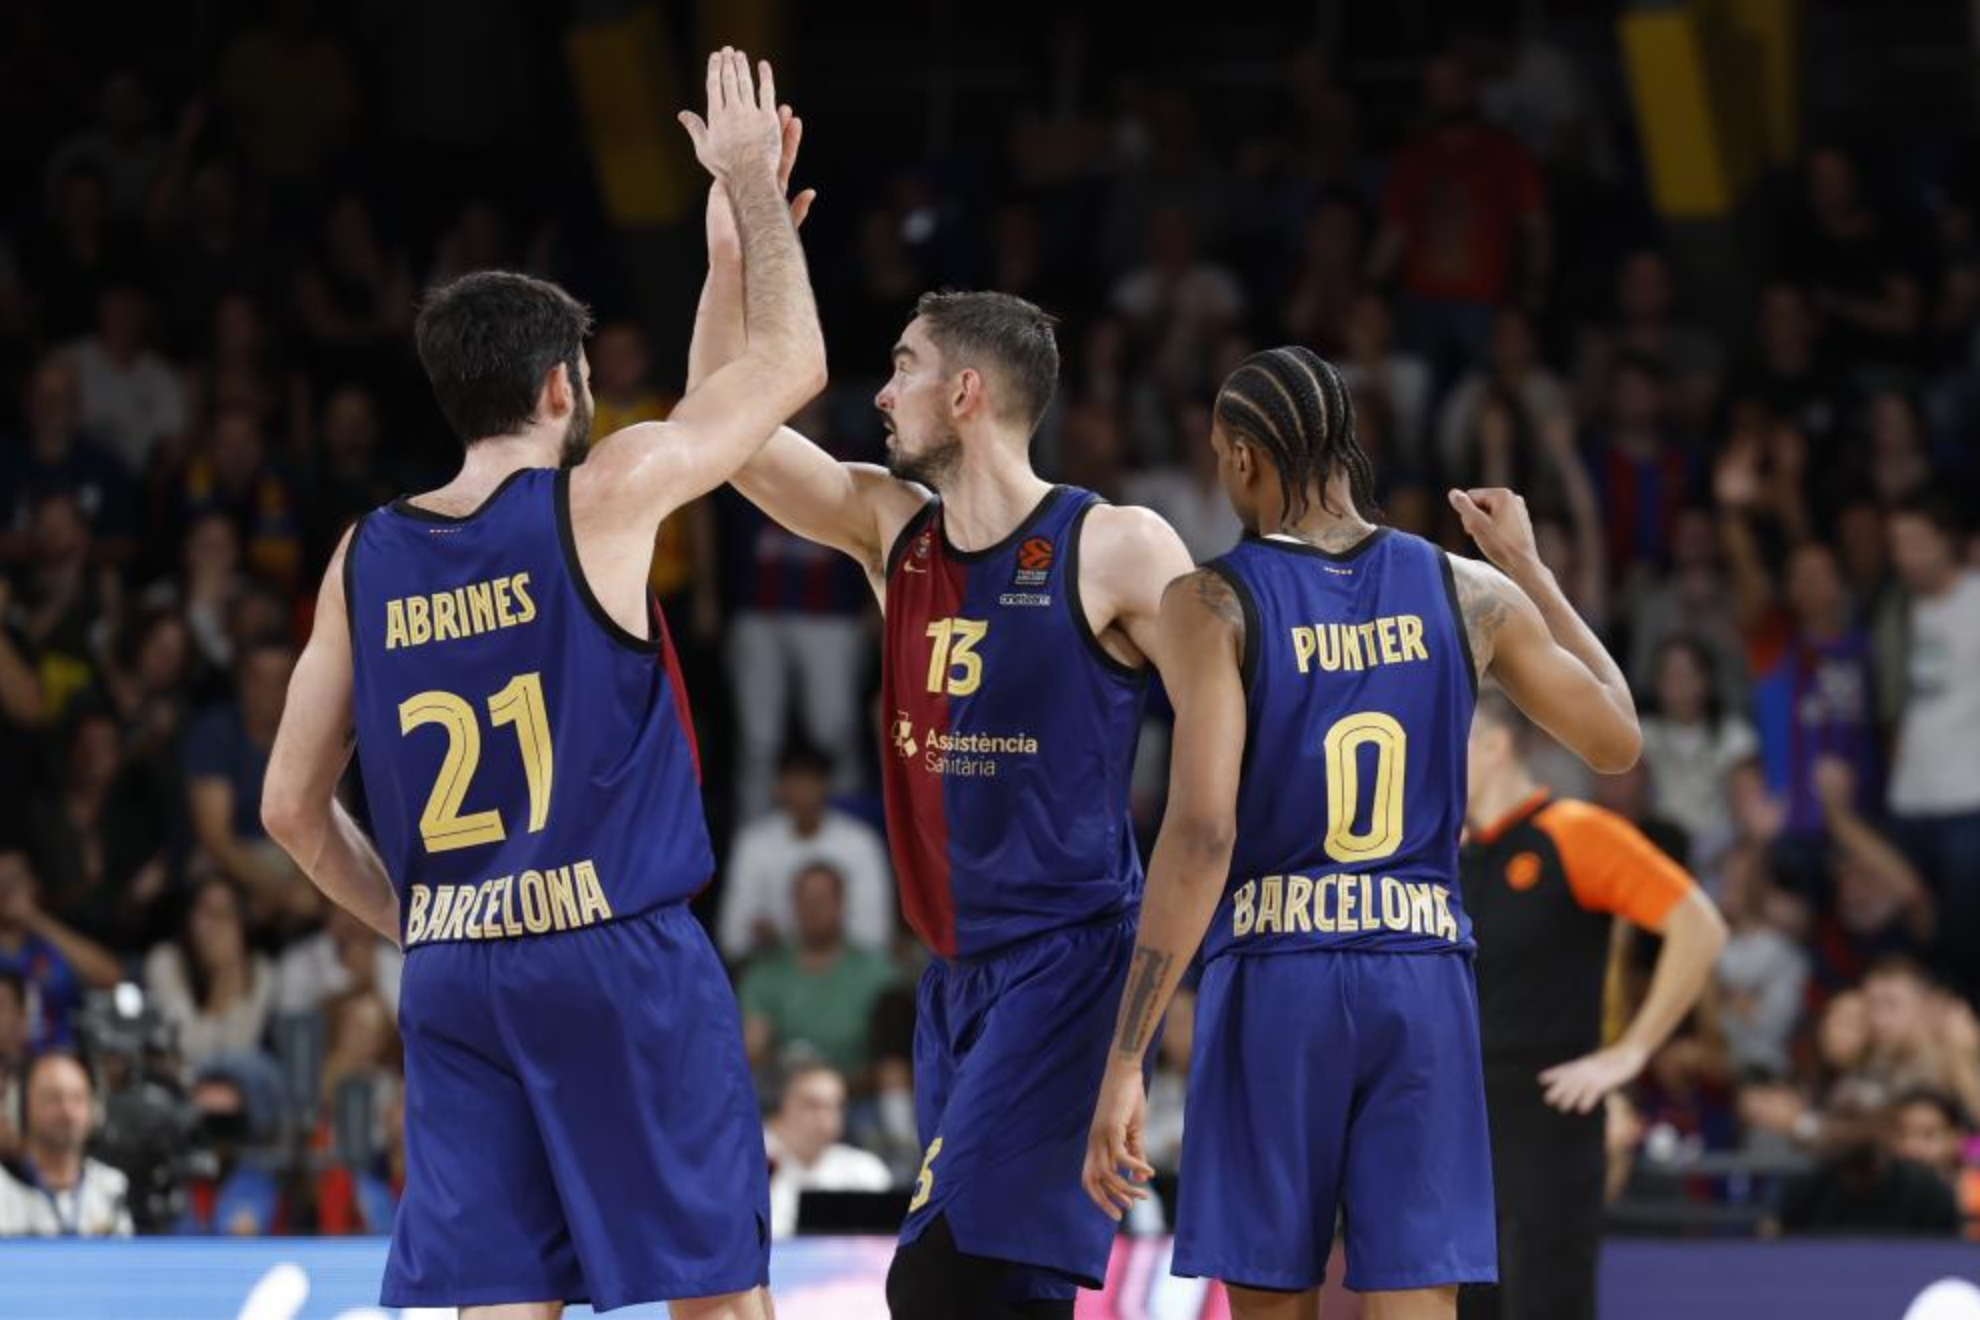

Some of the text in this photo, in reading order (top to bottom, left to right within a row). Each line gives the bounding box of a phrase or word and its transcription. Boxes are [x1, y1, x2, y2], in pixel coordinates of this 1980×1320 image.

[385, 573, 536, 649] ABRINES
[1292, 615, 1428, 673] PUNTER
[926, 617, 988, 695] 13
[399, 672, 553, 853] 21
[925, 728, 1037, 753] Assistència
[1324, 712, 1406, 863] 0
[406, 859, 612, 945] BARCELONA
[1234, 874, 1457, 941] BARCELONA
